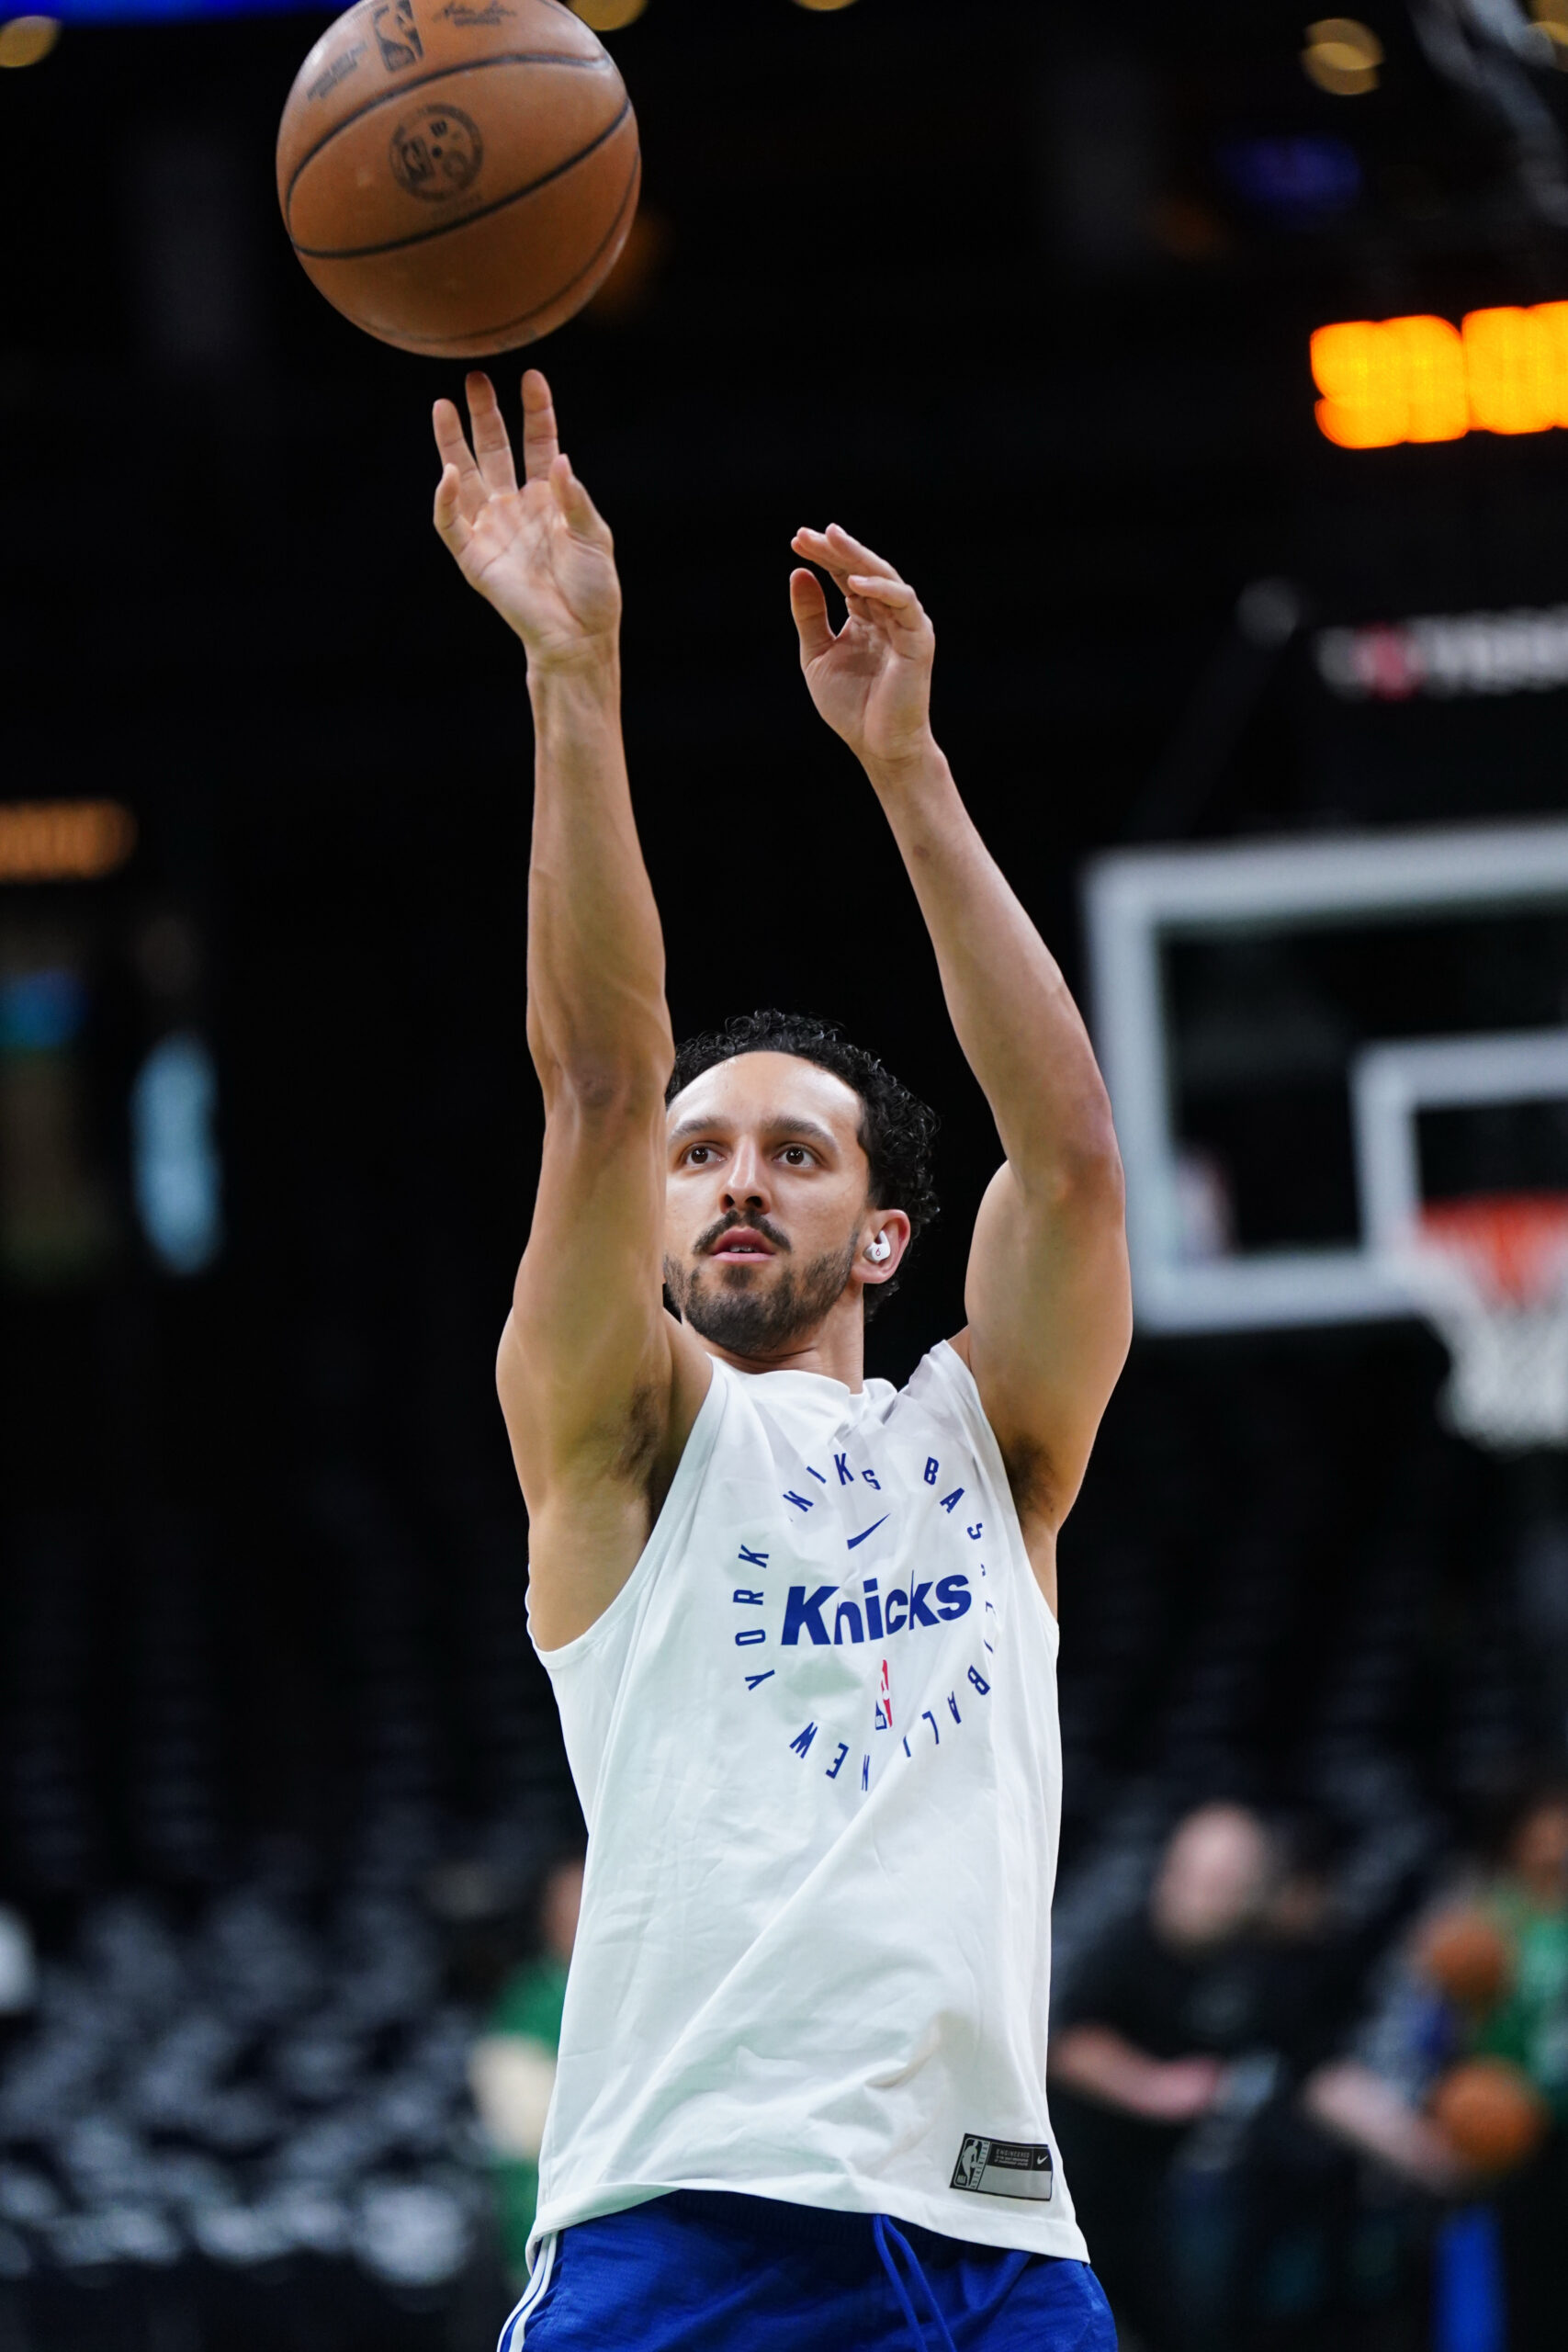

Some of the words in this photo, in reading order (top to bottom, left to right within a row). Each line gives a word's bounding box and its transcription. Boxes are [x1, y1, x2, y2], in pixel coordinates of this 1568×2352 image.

[732, 1544, 776, 1691] YORK
[780, 1569, 973, 1646] Knicks
[788, 1721, 872, 1792] NEW
